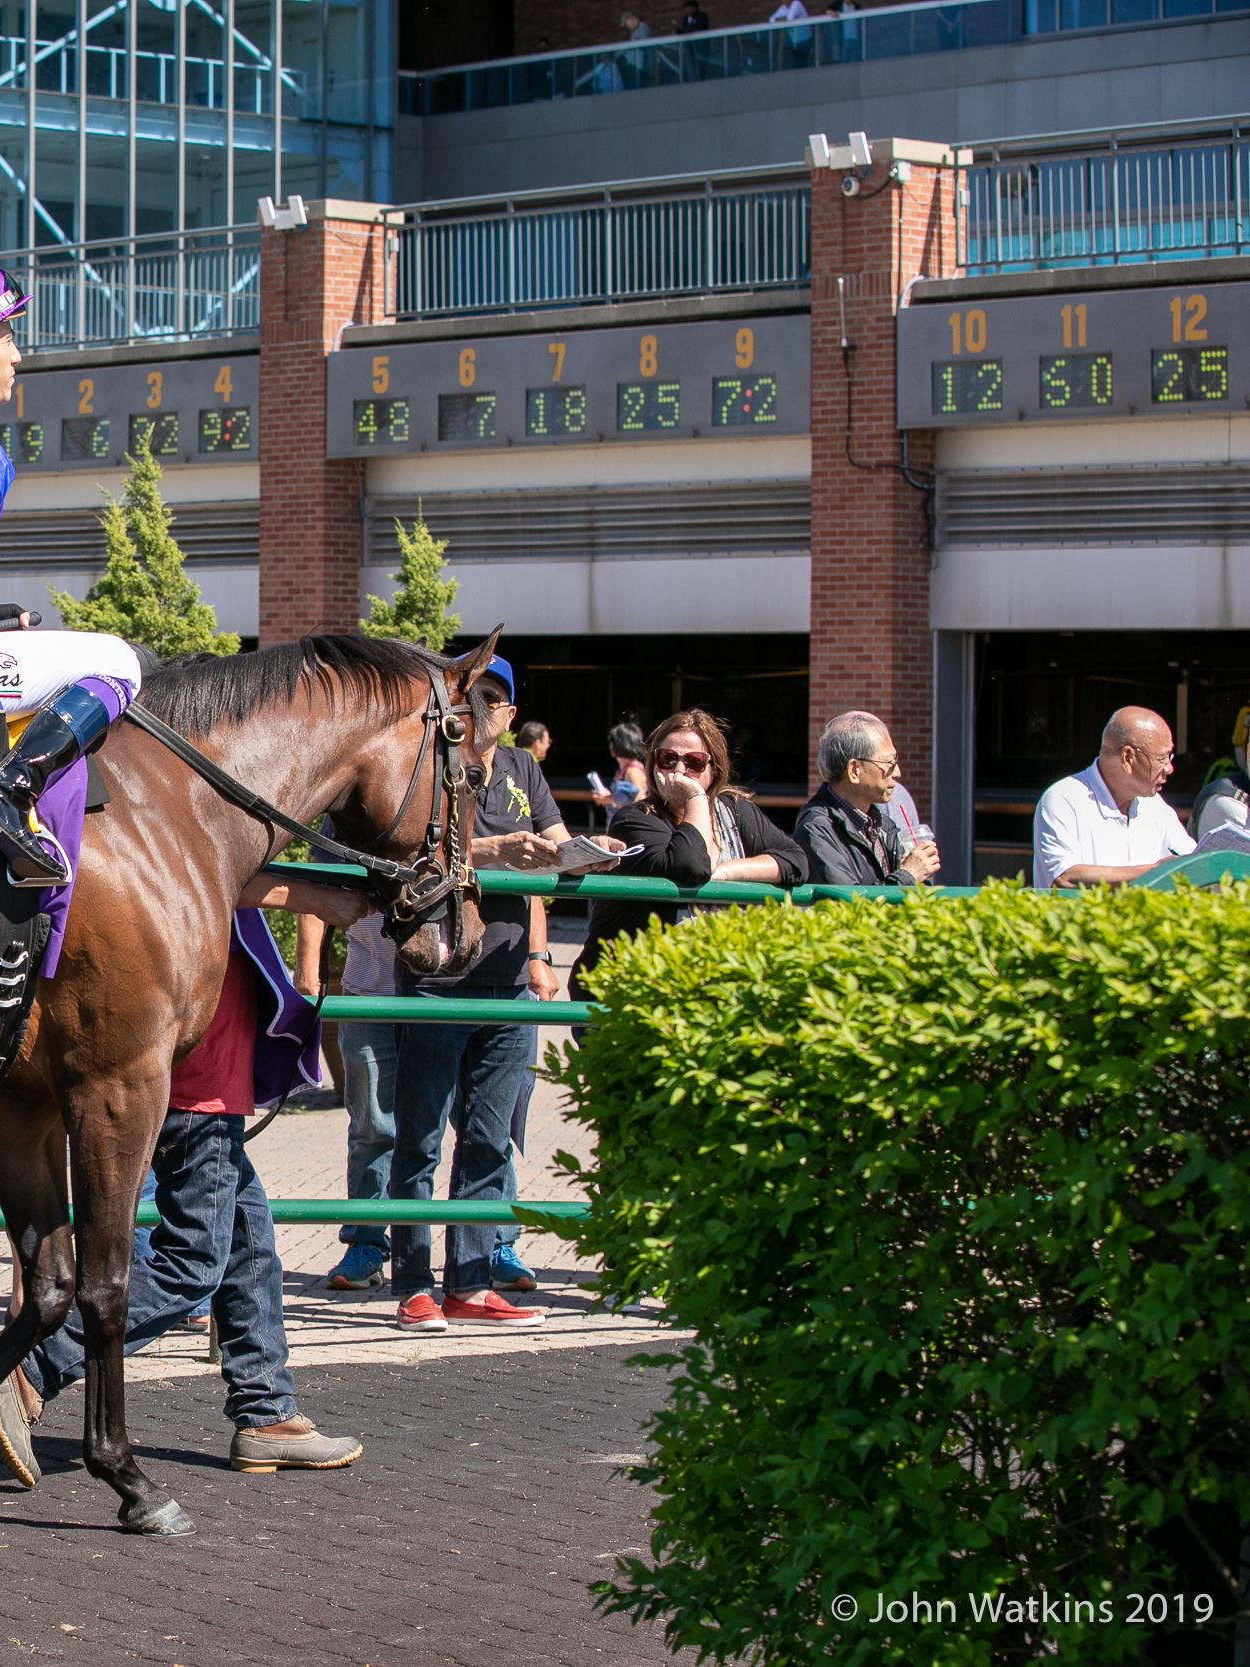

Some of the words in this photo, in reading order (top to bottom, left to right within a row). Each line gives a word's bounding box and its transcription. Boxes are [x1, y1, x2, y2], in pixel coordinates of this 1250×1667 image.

[948, 309, 987, 355] 10
[1060, 304, 1087, 348] 11
[1169, 294, 1208, 343] 12
[372, 356, 389, 394] 5
[458, 348, 476, 387] 6
[548, 343, 566, 382] 7
[639, 335, 657, 377] 8
[735, 328, 754, 369] 9
[941, 363, 1002, 413] 12
[1157, 350, 1228, 402] 25
[15, 383, 24, 419] 1
[78, 379, 94, 414] 2
[146, 371, 163, 408] 3
[214, 366, 233, 403] 4
[358, 402, 409, 443] 48
[531, 392, 586, 434] 18
[622, 384, 681, 430] 25
